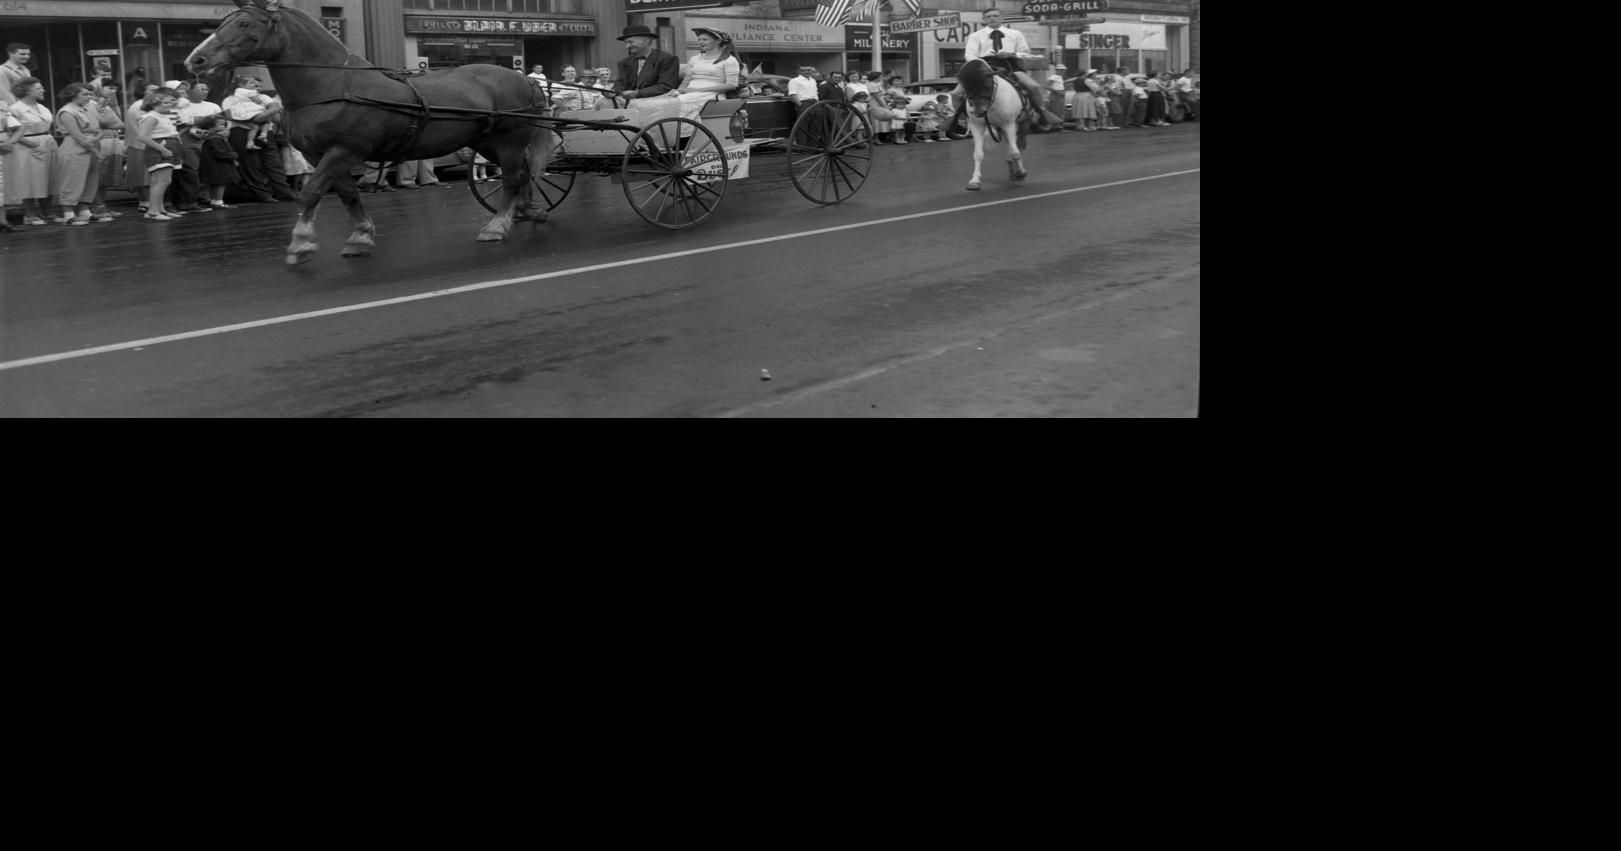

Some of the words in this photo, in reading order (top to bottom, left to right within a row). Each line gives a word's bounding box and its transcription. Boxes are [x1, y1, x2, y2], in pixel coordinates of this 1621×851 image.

[1025, 1, 1099, 13] SODA-GRILL
[522, 21, 557, 32] UBER
[744, 23, 790, 31] INDIANA
[892, 18, 931, 32] BARBER
[933, 14, 958, 27] SHOP
[783, 34, 823, 42] CENTER
[853, 39, 910, 48] MILNERY
[1080, 34, 1130, 49] SINGER
